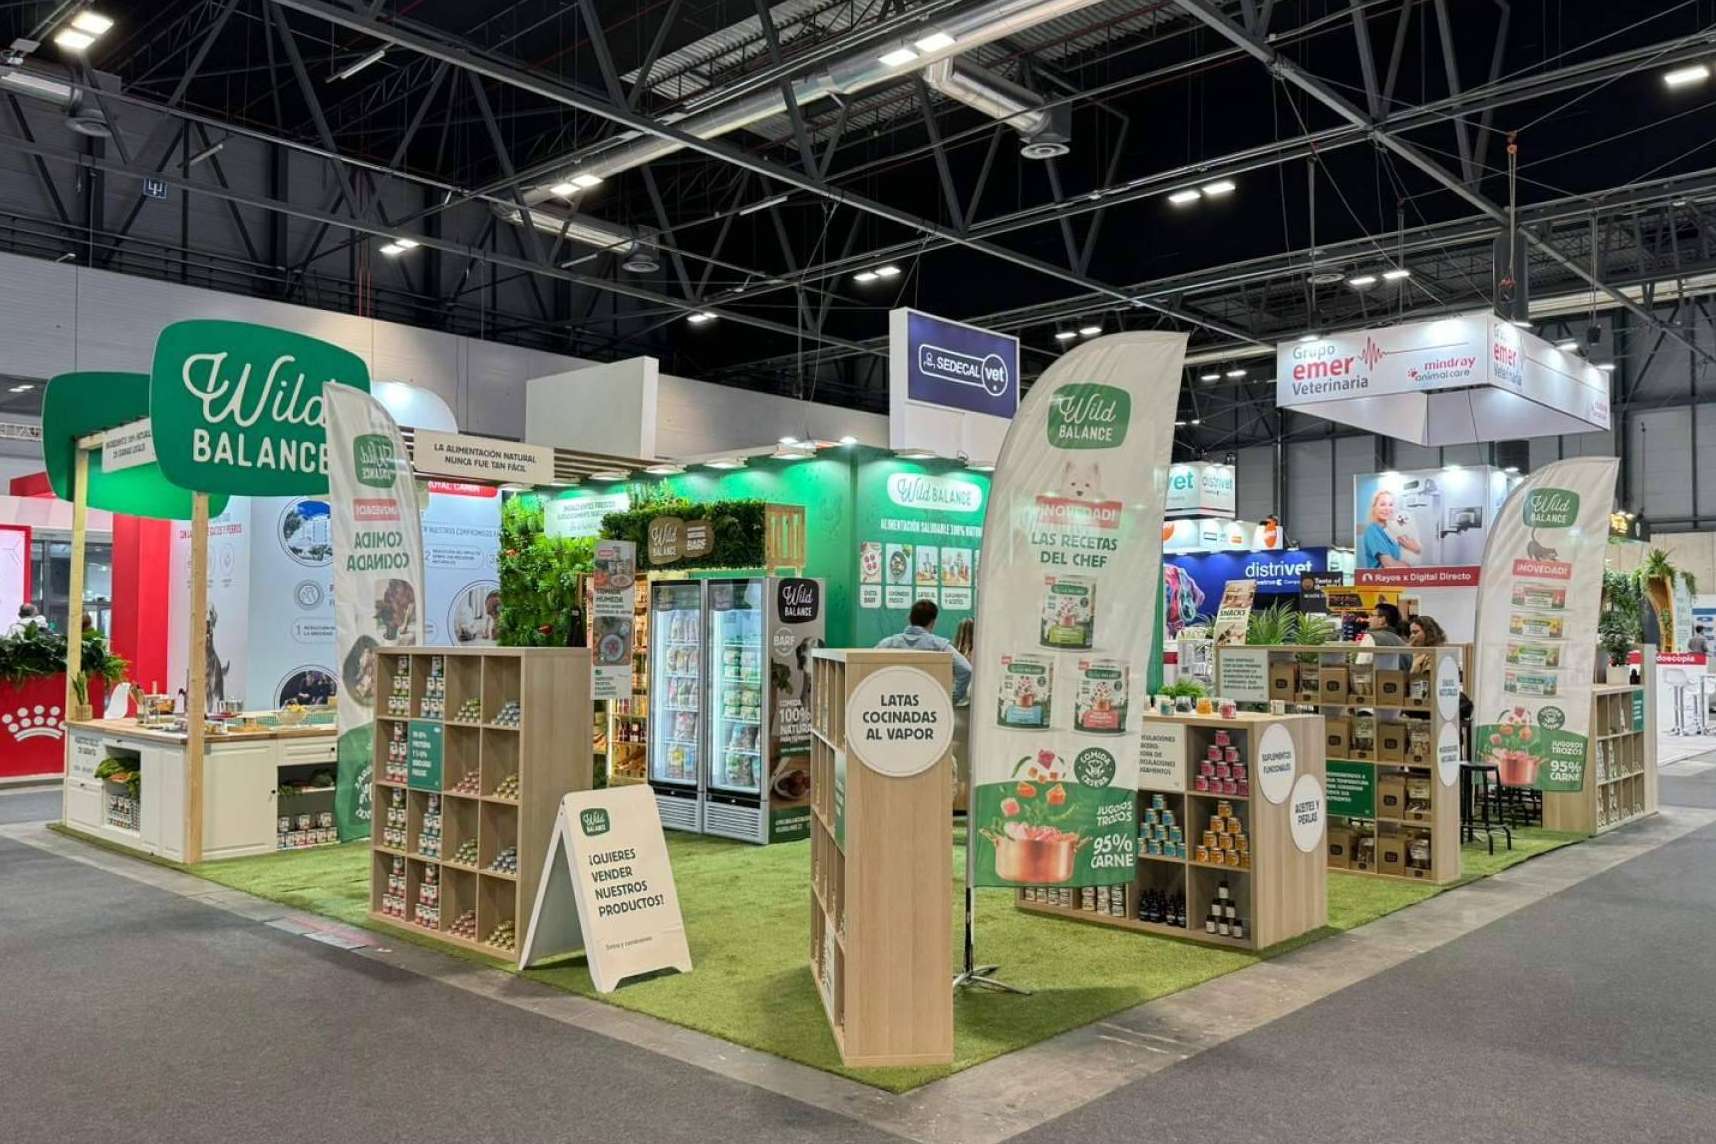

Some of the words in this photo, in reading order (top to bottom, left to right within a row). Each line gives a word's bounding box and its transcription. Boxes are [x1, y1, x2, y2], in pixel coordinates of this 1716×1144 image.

[1292, 345, 1336, 361] Grupo
[936, 356, 980, 378] SEDECAL
[1293, 356, 1355, 381] emer
[1424, 355, 1476, 370] mindray
[985, 366, 1004, 382] vet
[1292, 375, 1369, 396] Veterinaria
[1058, 394, 1117, 424] Wild
[1058, 424, 1113, 441] BALANCE
[434, 443, 444, 451] LA
[446, 444, 501, 460] ALIMENTACIÓN
[503, 453, 536, 464] NATURAL
[444, 455, 473, 466] NUNCA
[474, 459, 490, 468] FUE
[491, 461, 506, 470] TAN
[507, 462, 526, 472] FÁCIL
[897, 477, 930, 503] Wild
[932, 487, 972, 506] BALANCE
[1530, 493, 1570, 512] Wild
[1530, 513, 1569, 523] BALANCE
[1031, 531, 1056, 546] LAS
[1061, 534, 1119, 551] RECETAS
[1040, 551, 1068, 565] DEL
[1072, 553, 1108, 568] CHEF
[1244, 560, 1313, 578] distrivet
[1375, 573, 1401, 583] Rayos
[1410, 572, 1437, 583] Digital
[1440, 572, 1472, 581] Directo
[782, 584, 815, 606] Wild
[784, 606, 813, 617] BALANCE
[773, 635, 796, 646] BARF
[880, 694, 919, 707] LATAS
[862, 711, 937, 724] COCINADAS
[866, 728, 882, 740] AL
[887, 728, 934, 740] VAPOR
[1080, 751, 1111, 766] COMIDA
[1550, 760, 1582, 773] 95%
[1096, 801, 1134, 816] JUGOSOS
[1096, 811, 1133, 827] TROZOS
[1093, 833, 1134, 856] 95%
[1090, 854, 1135, 869] CARNE
[591, 866, 633, 883] VENDER
[594, 880, 648, 901] NUESTROS
